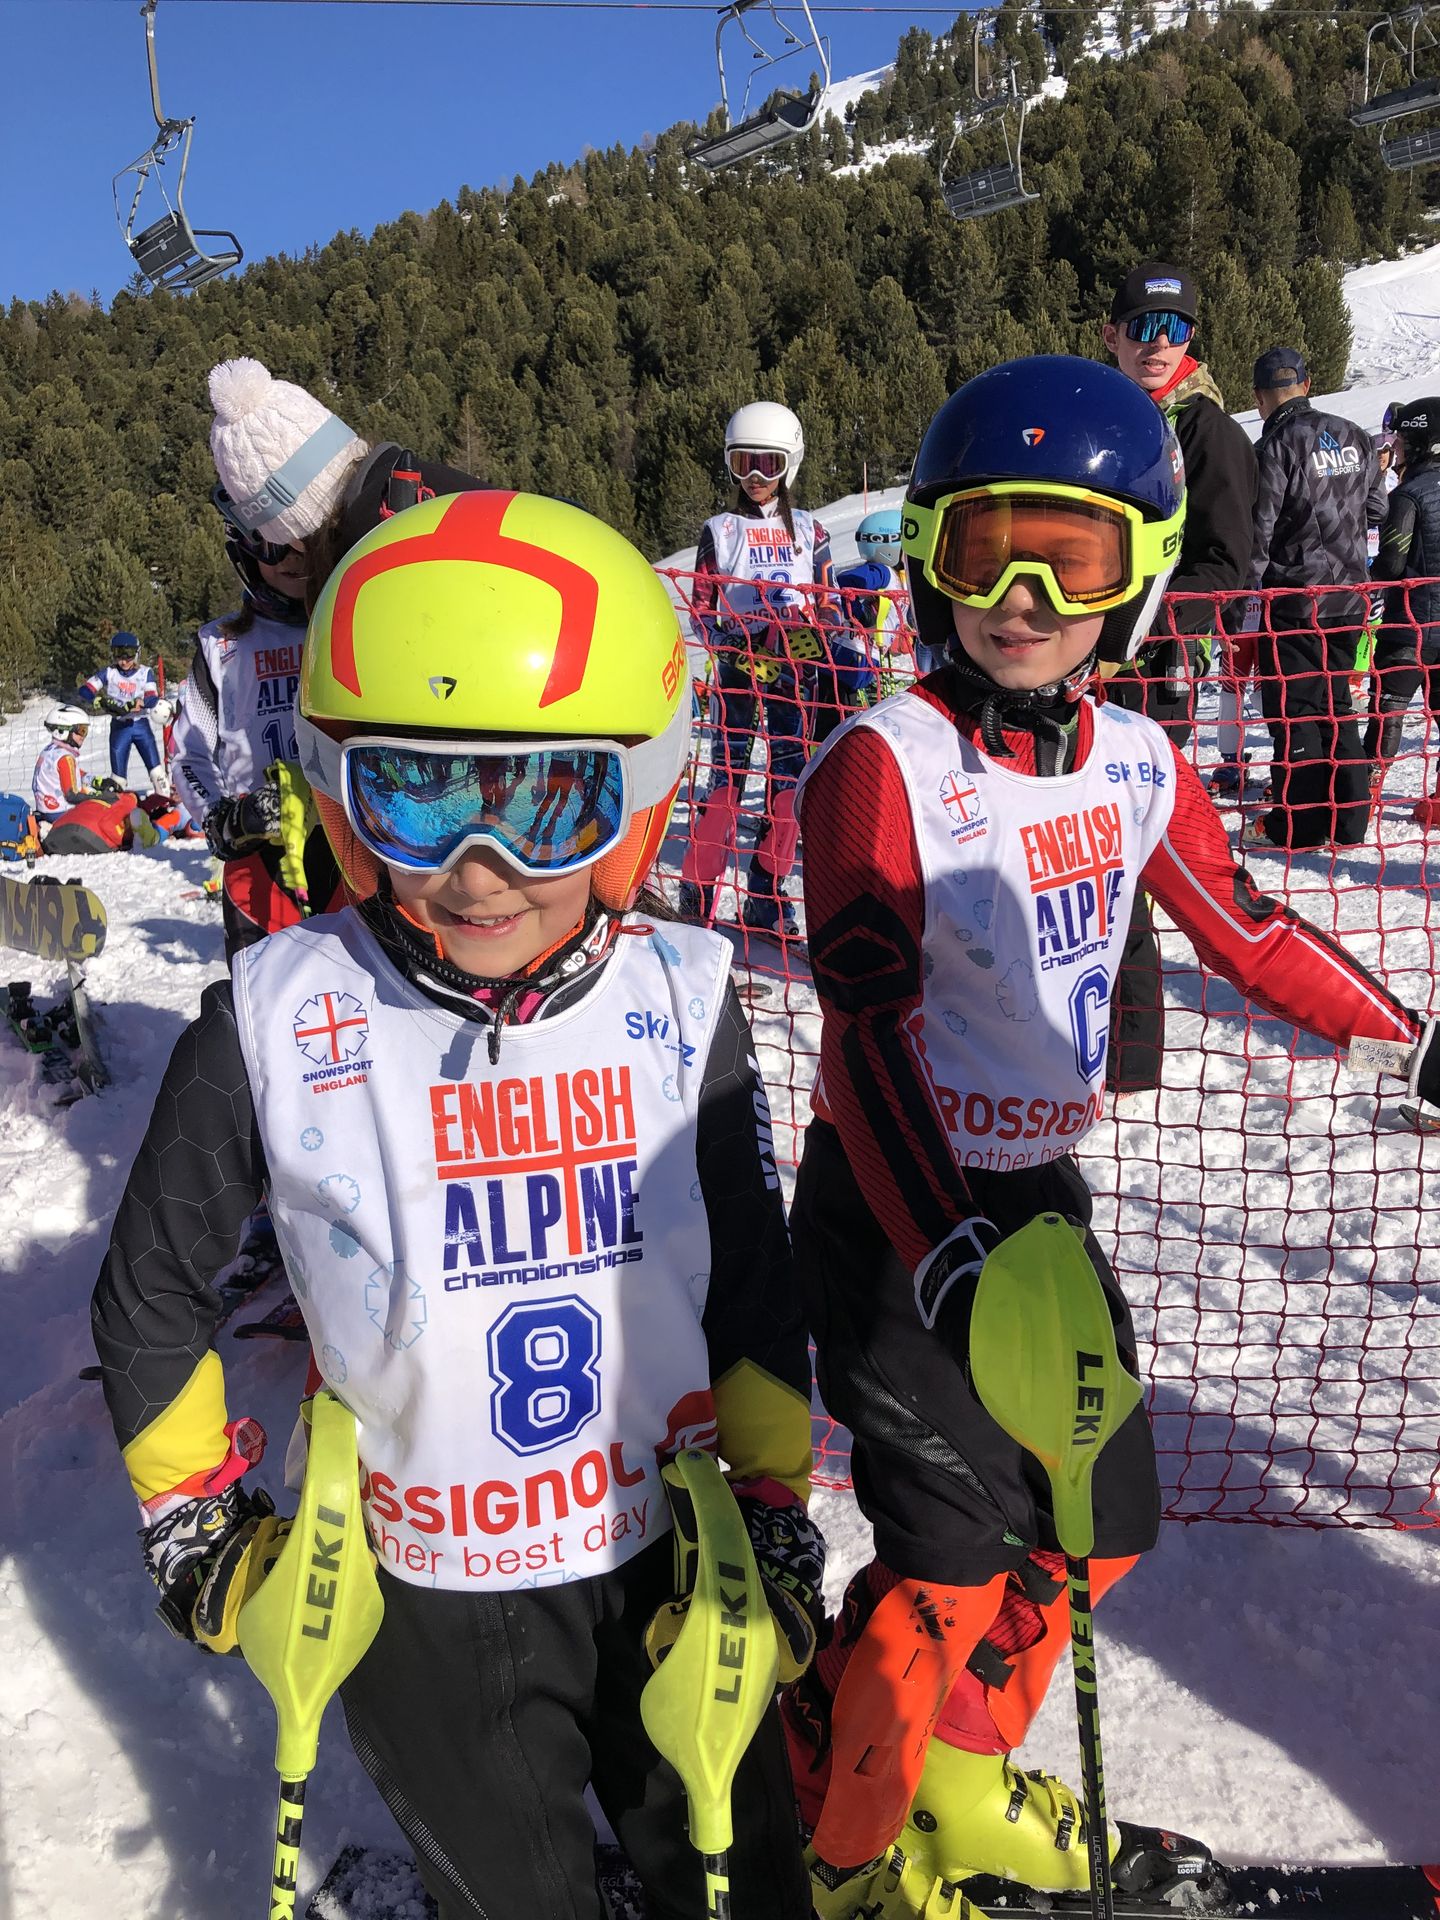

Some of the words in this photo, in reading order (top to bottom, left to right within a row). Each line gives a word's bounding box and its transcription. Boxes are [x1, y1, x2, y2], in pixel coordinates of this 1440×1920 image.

[240, 494, 273, 521] POC
[746, 527, 791, 543] ENGLISH
[749, 546, 794, 564] ALPINE
[950, 816, 989, 838] SNOWSPORT
[957, 828, 987, 845] ENGLAND
[1019, 802, 1124, 881] ENGLISH
[625, 1011, 670, 1040] Ski
[302, 1060, 374, 1083] SNOWSPORT
[312, 1074, 368, 1094] ENGLAND
[429, 1065, 636, 1163] ENGLISH
[443, 1160, 644, 1271] ALPINE
[443, 1247, 644, 1292] championships
[486, 1293, 602, 1457] 8
[1072, 1350, 1104, 1445] LEKI
[464, 1532, 565, 1578] best
[583, 1497, 649, 1552] day
[302, 1504, 346, 1641] LEKI
[714, 1561, 748, 1705] LEKI
[1066, 1574, 1098, 1694] LEKI
